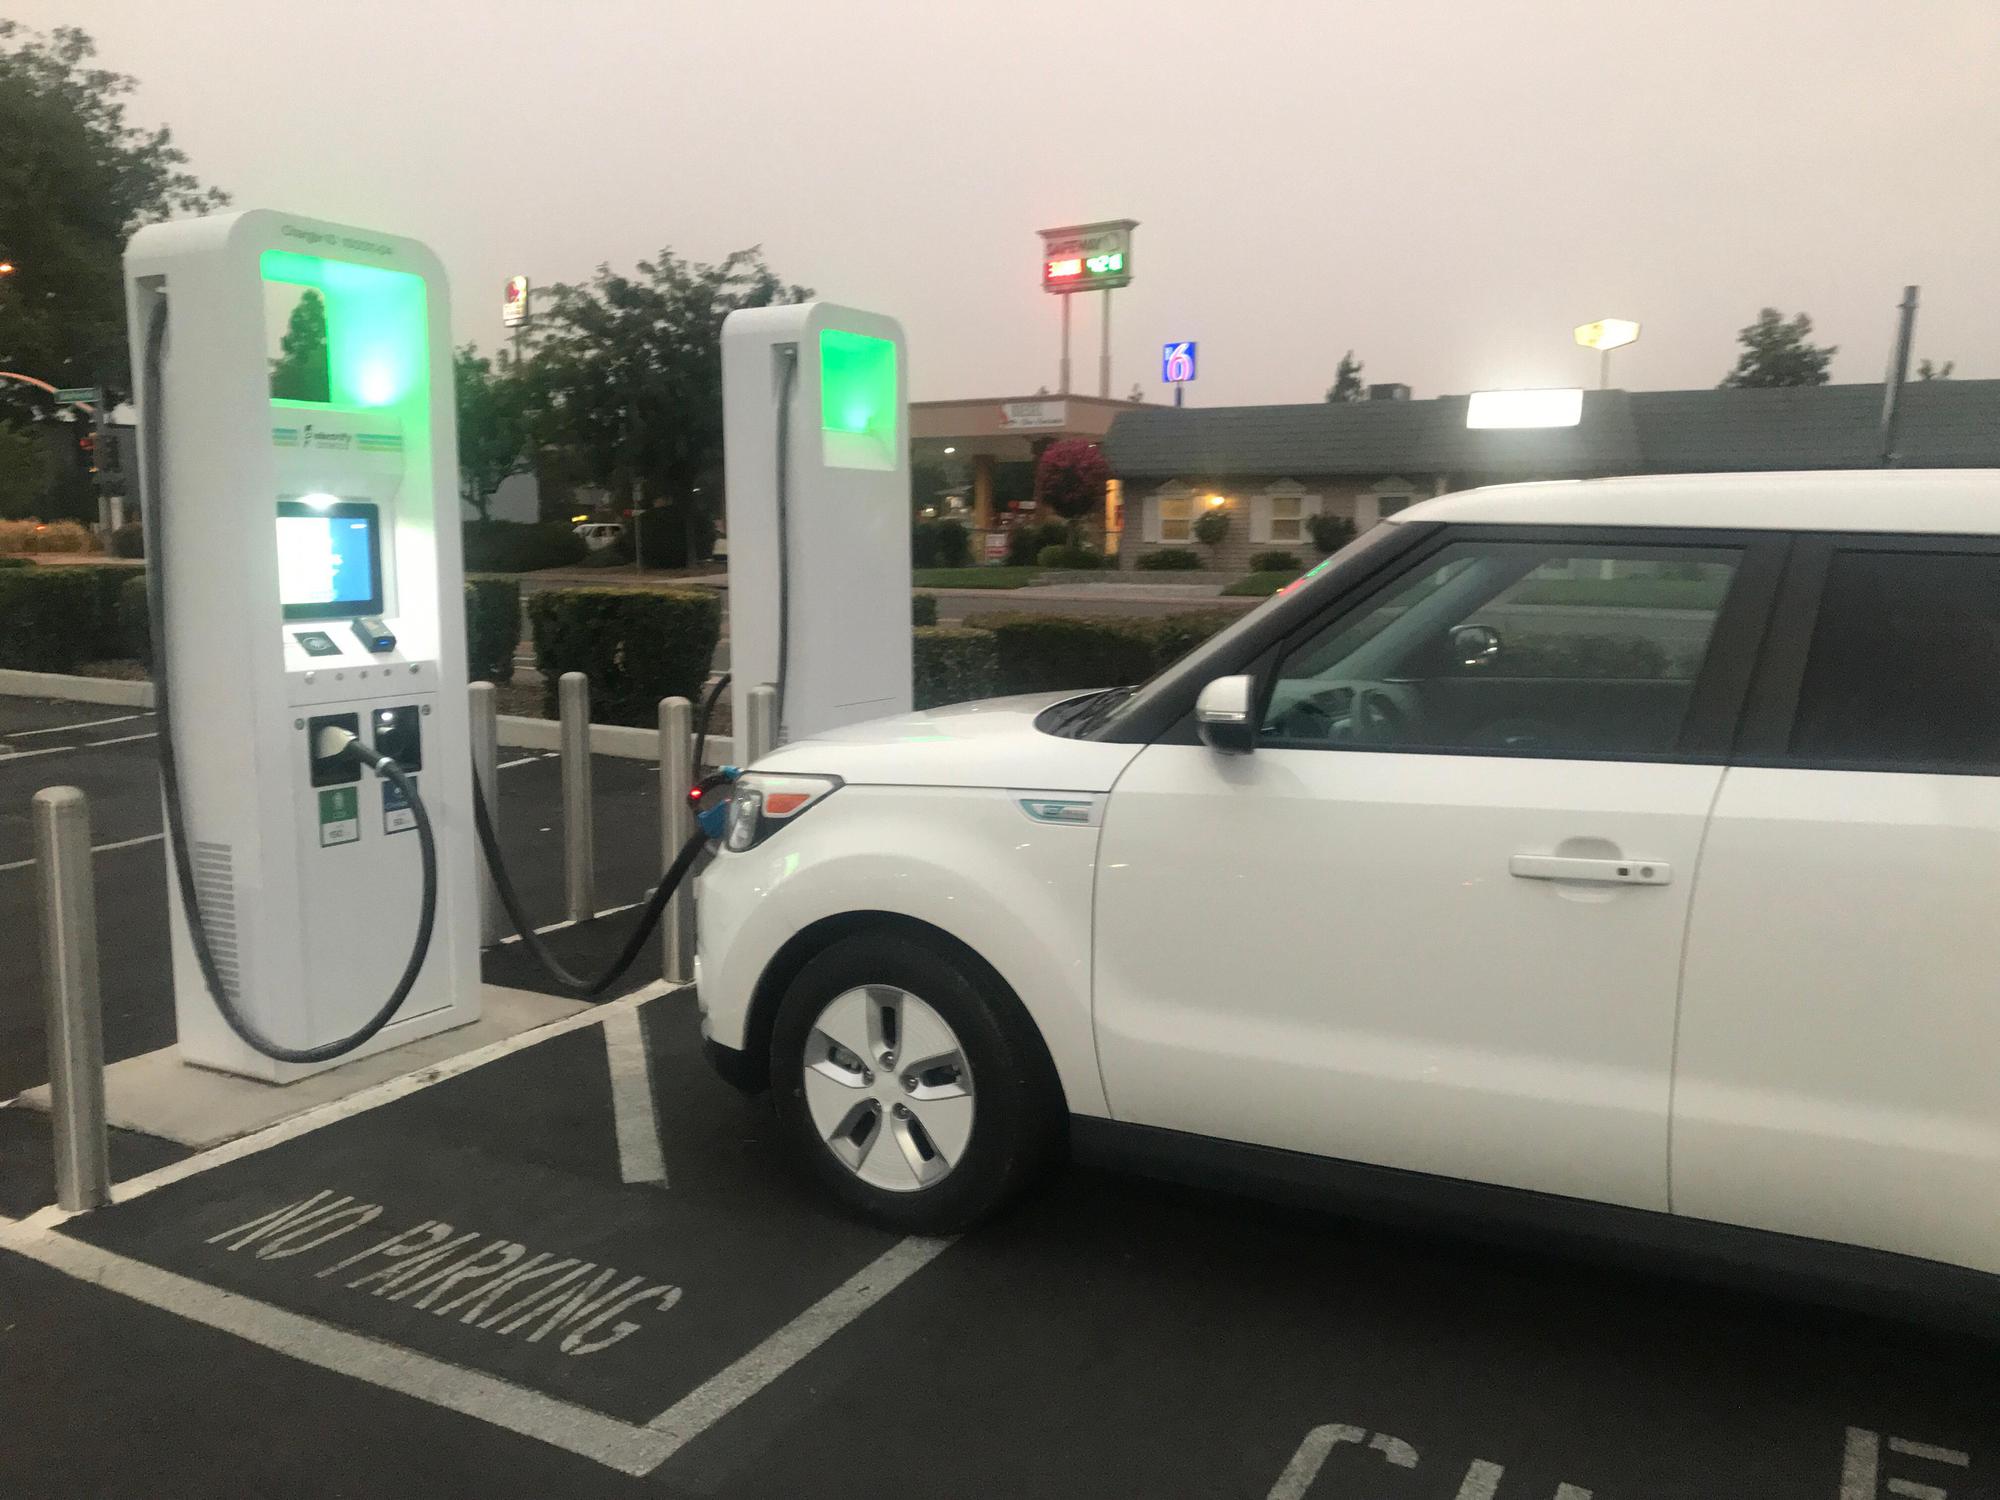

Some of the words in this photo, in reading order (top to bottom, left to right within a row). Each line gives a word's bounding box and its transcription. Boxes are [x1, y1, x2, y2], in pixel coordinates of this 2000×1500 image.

[1166, 342, 1194, 382] 6
[204, 1189, 384, 1261] NO
[313, 1219, 684, 1357] PARKING
